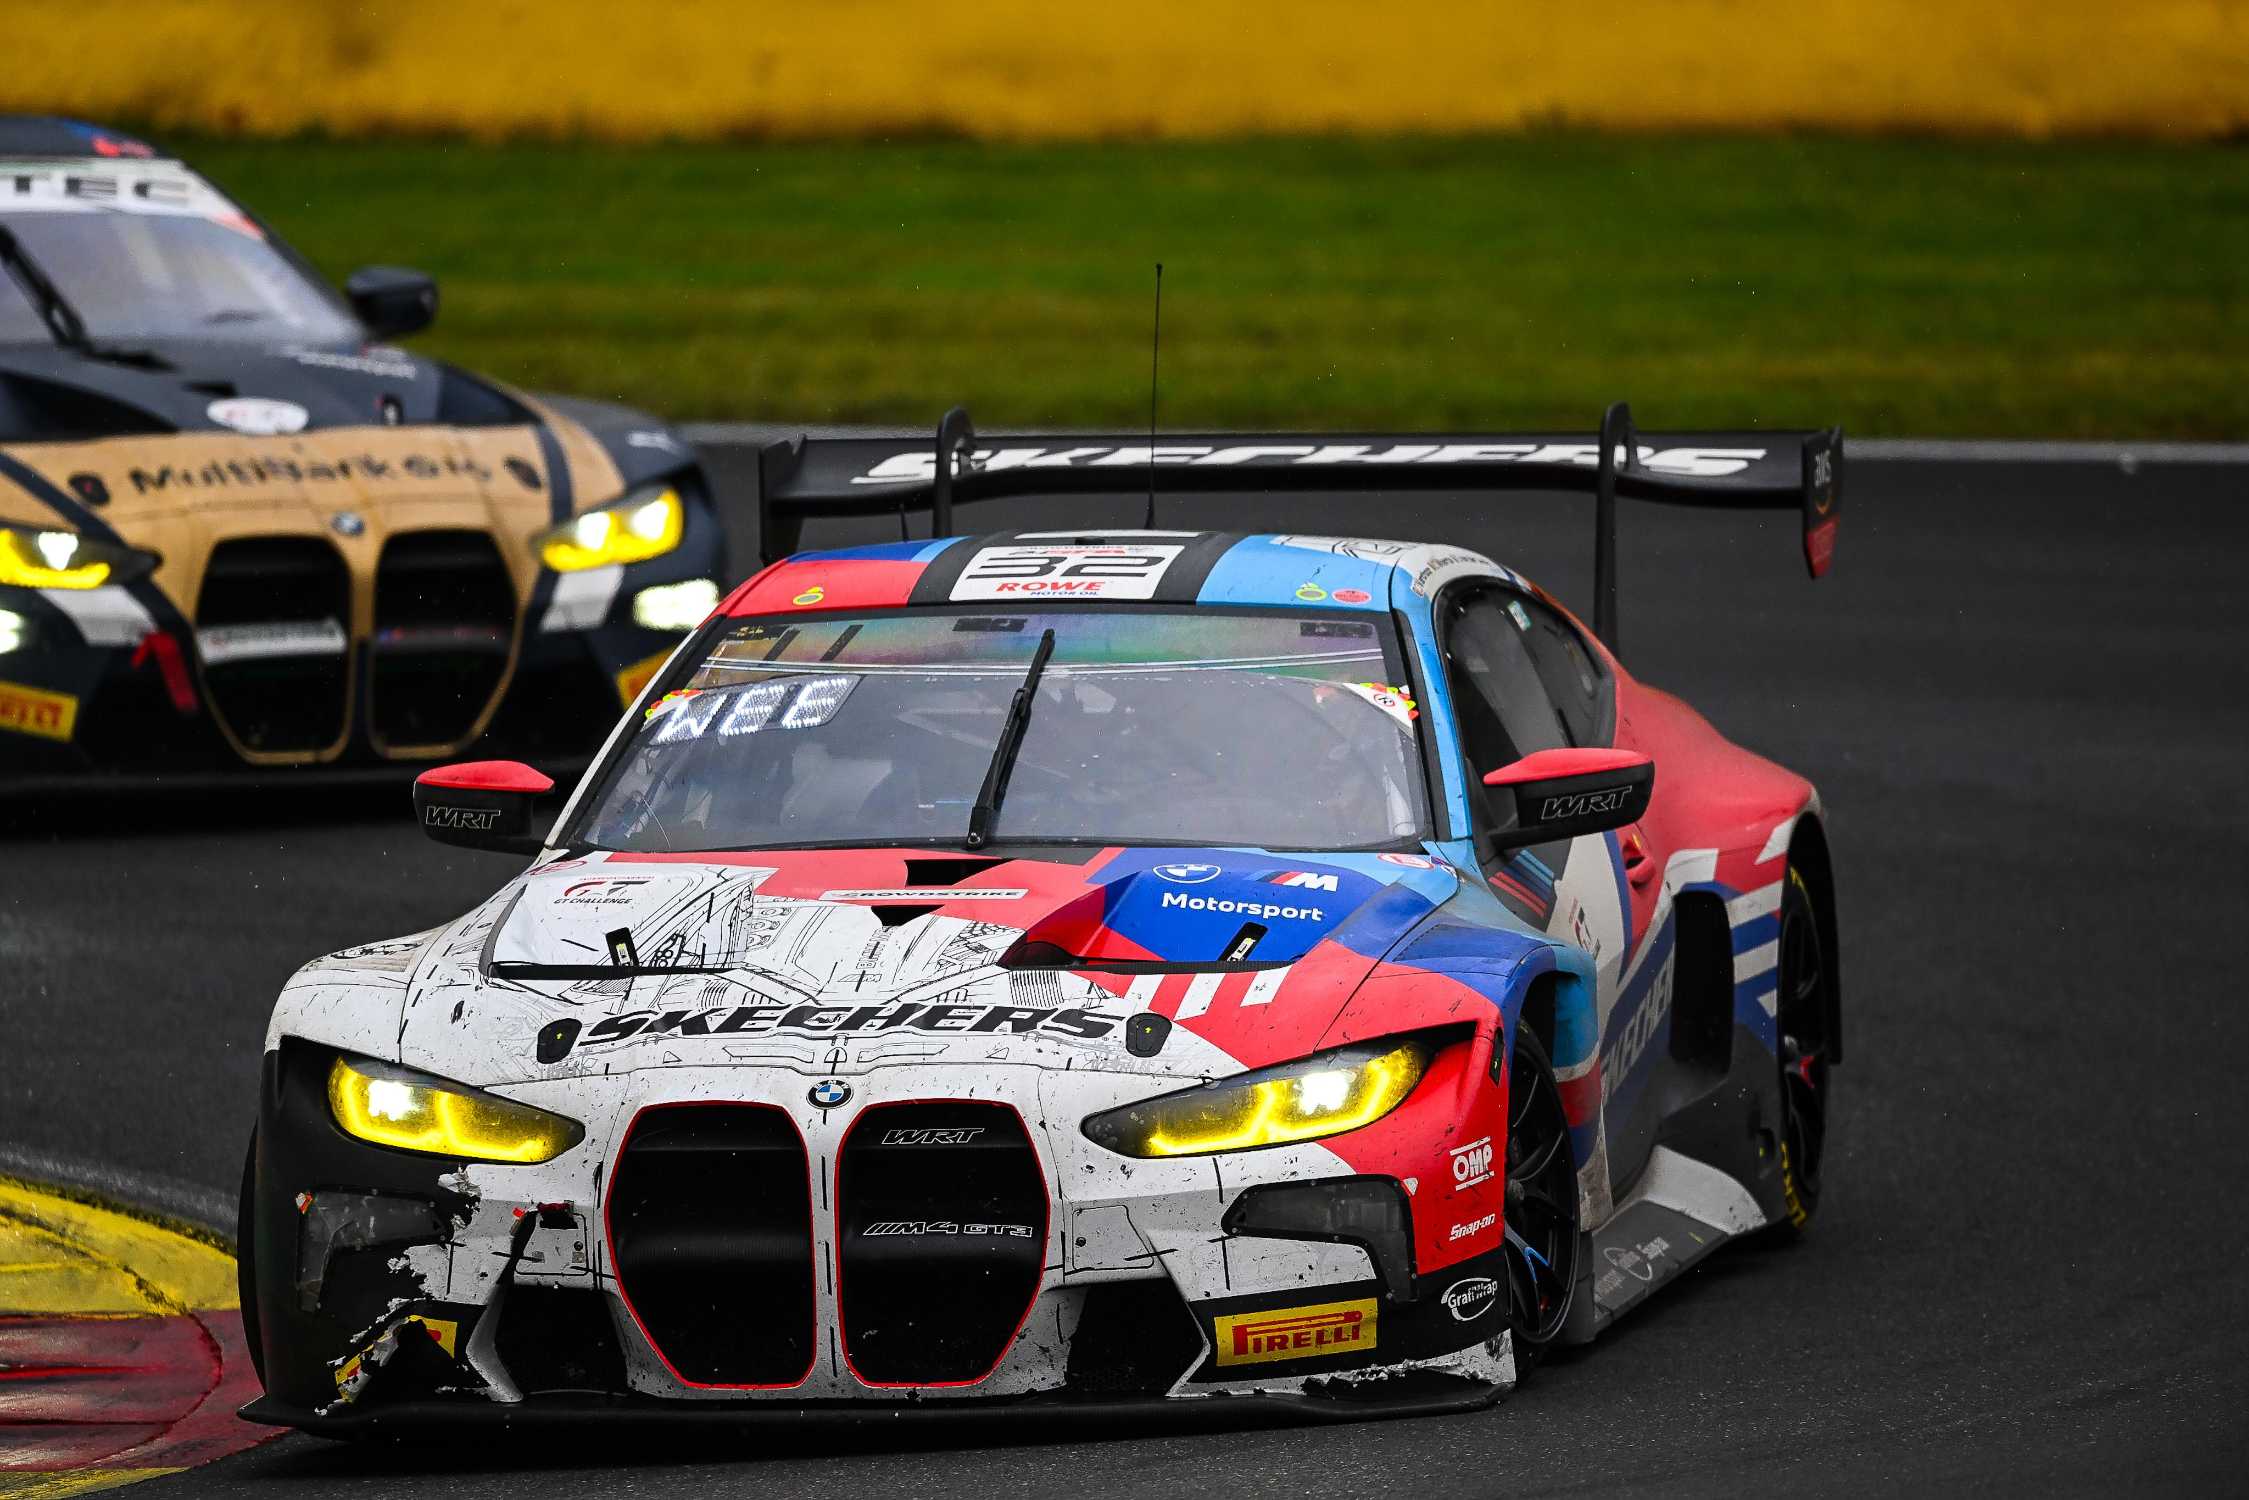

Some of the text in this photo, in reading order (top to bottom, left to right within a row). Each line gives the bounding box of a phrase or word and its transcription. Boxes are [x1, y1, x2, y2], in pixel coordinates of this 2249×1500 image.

[965, 556, 1167, 580] 32
[995, 581, 1107, 592] ROWE
[1541, 785, 1633, 820] WRT
[425, 805, 502, 830] WRT
[1162, 892, 1323, 921] Motorsport
[577, 1002, 1127, 1047] SKECHERS
[881, 1127, 986, 1145] WRT
[1452, 1144, 1493, 1182] OMP
[963, 1223, 1033, 1238] GT3
[1449, 1212, 1496, 1242] Snap-on
[1231, 1310, 1364, 1357] PIRELLI
